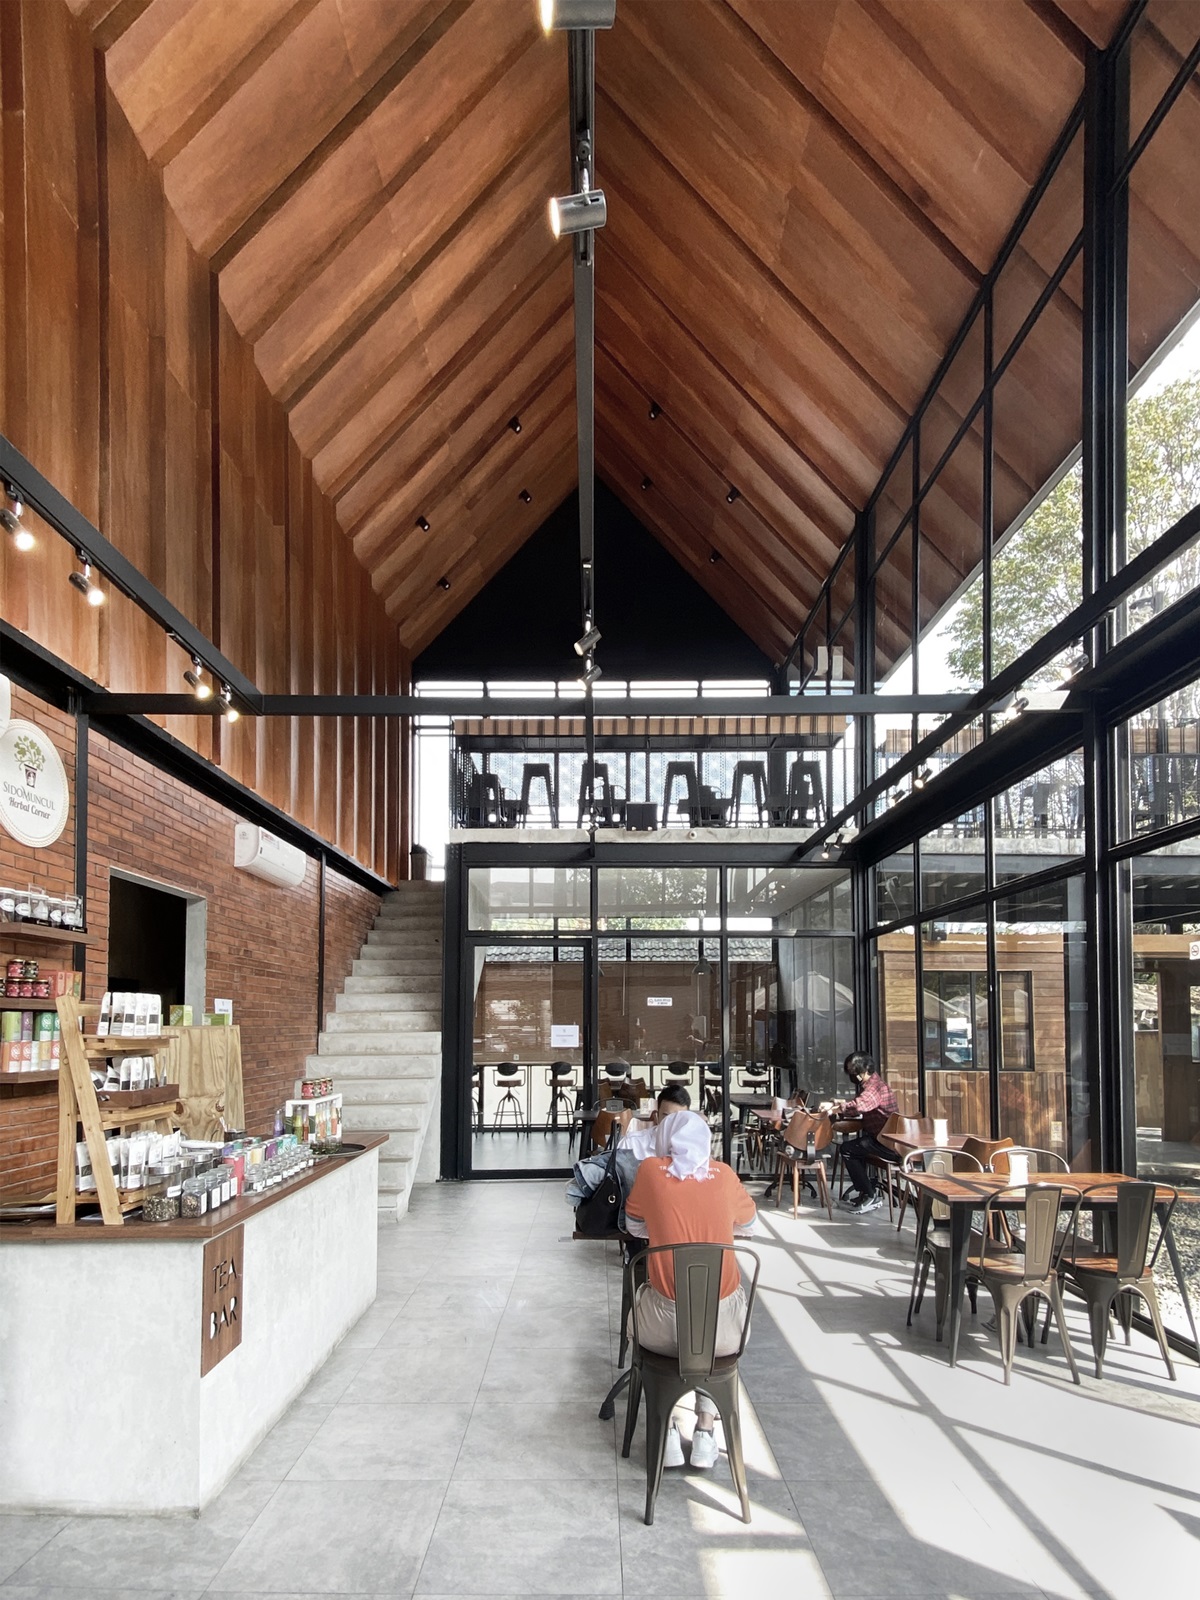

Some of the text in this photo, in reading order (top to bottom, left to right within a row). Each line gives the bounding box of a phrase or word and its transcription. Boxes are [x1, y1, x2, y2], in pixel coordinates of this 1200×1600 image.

[8, 796, 51, 819] Herbal Corner
[212, 1256, 238, 1294] TEA
[210, 1296, 238, 1340] BAR
